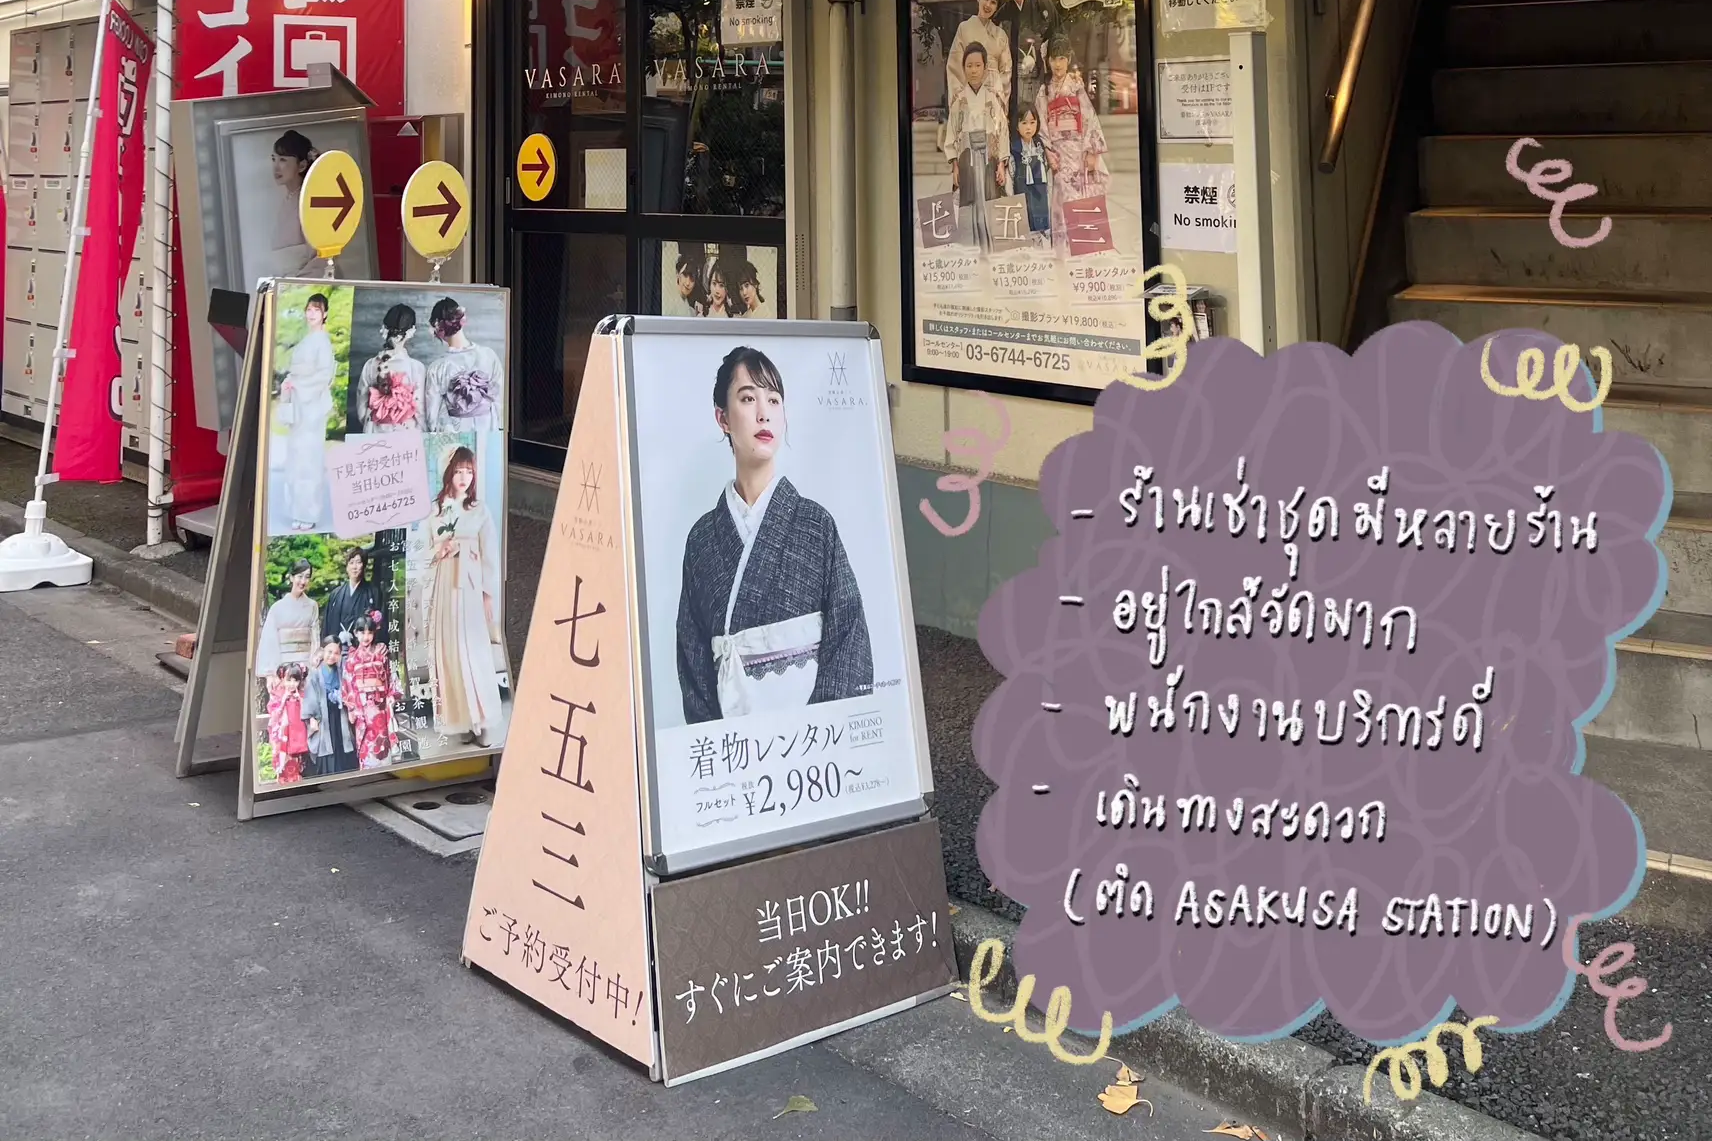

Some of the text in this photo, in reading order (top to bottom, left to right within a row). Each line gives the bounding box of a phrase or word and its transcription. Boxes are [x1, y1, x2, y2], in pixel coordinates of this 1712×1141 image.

[729, 14, 773, 26] No smoking
[525, 62, 622, 89] VASARA
[653, 52, 771, 86] VASARA
[1184, 185, 1218, 205] 禁煙
[922, 200, 1106, 244] 七 五 三
[1174, 214, 1191, 226] No
[927, 258, 972, 270] 七歳レンタル
[998, 262, 1047, 274] 五歳レンタル
[1075, 267, 1129, 279] 三歳レンタル
[992, 275, 1029, 288] ¥13,900
[1072, 281, 1106, 293] ¥9,900
[1021, 310, 1060, 324] 撮影プラン
[966, 343, 1070, 372] 03-6744-6725
[332, 449, 418, 480] 下見予約受付中!
[352, 470, 404, 494] 当日もOK!
[347, 495, 416, 520] 03-6744-6725
[848, 716, 883, 731] KIMONO
[532, 574, 607, 910] 七五三
[849, 728, 884, 743] for RENT
[689, 723, 845, 780] 着物レンタル
[695, 794, 737, 813] フルセット
[756, 879, 870, 943] 当日OK!!
[479, 905, 644, 1027] ご予約受付中!
[675, 911, 938, 1025] すぐにご案内できます!
